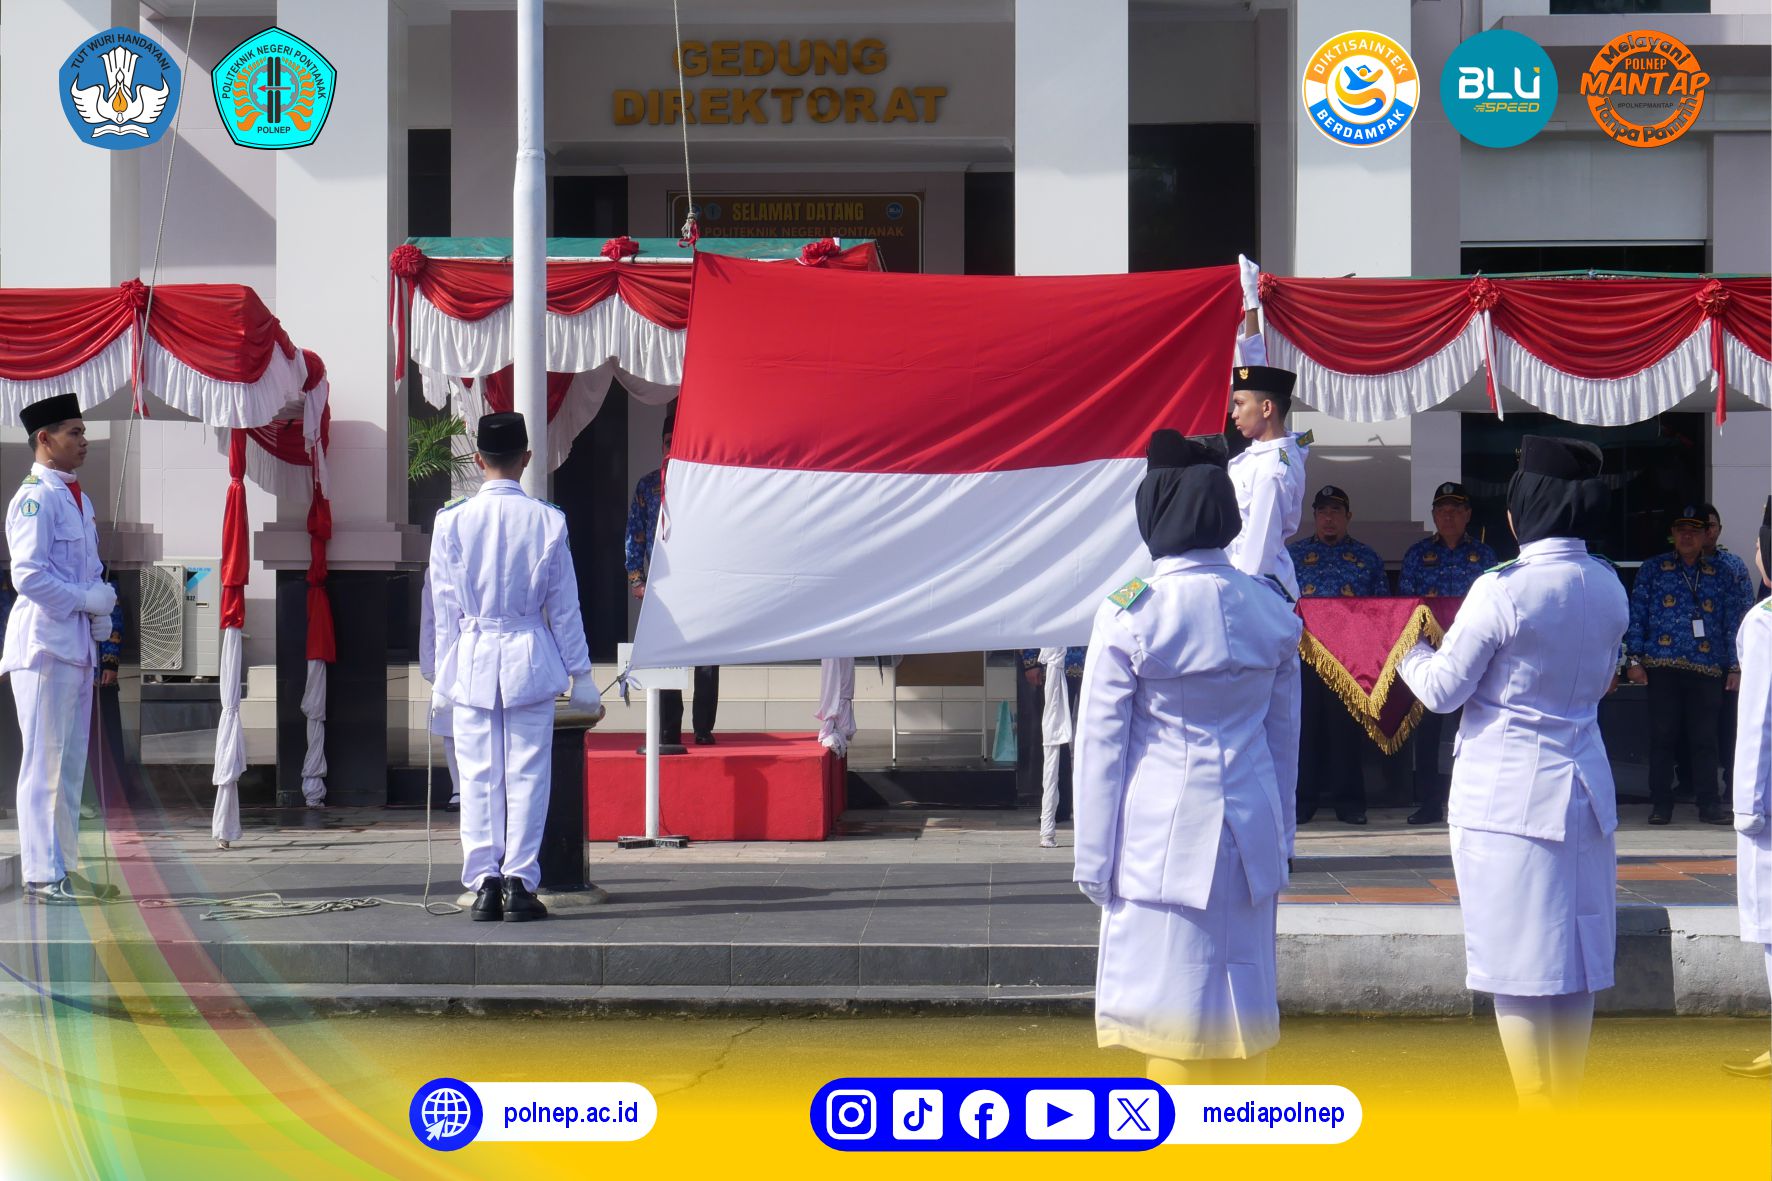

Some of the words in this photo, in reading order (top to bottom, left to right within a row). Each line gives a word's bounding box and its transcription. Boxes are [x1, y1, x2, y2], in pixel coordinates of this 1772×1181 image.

[672, 38, 888, 77] GEDUNG
[612, 86, 948, 126] DIREKTORAT
[732, 203, 800, 221] SELAMAT
[806, 202, 864, 221] DATANG
[705, 226, 777, 238] POLITEKNIK
[782, 226, 825, 238] NEGERI
[830, 226, 904, 238] PONTIANAK
